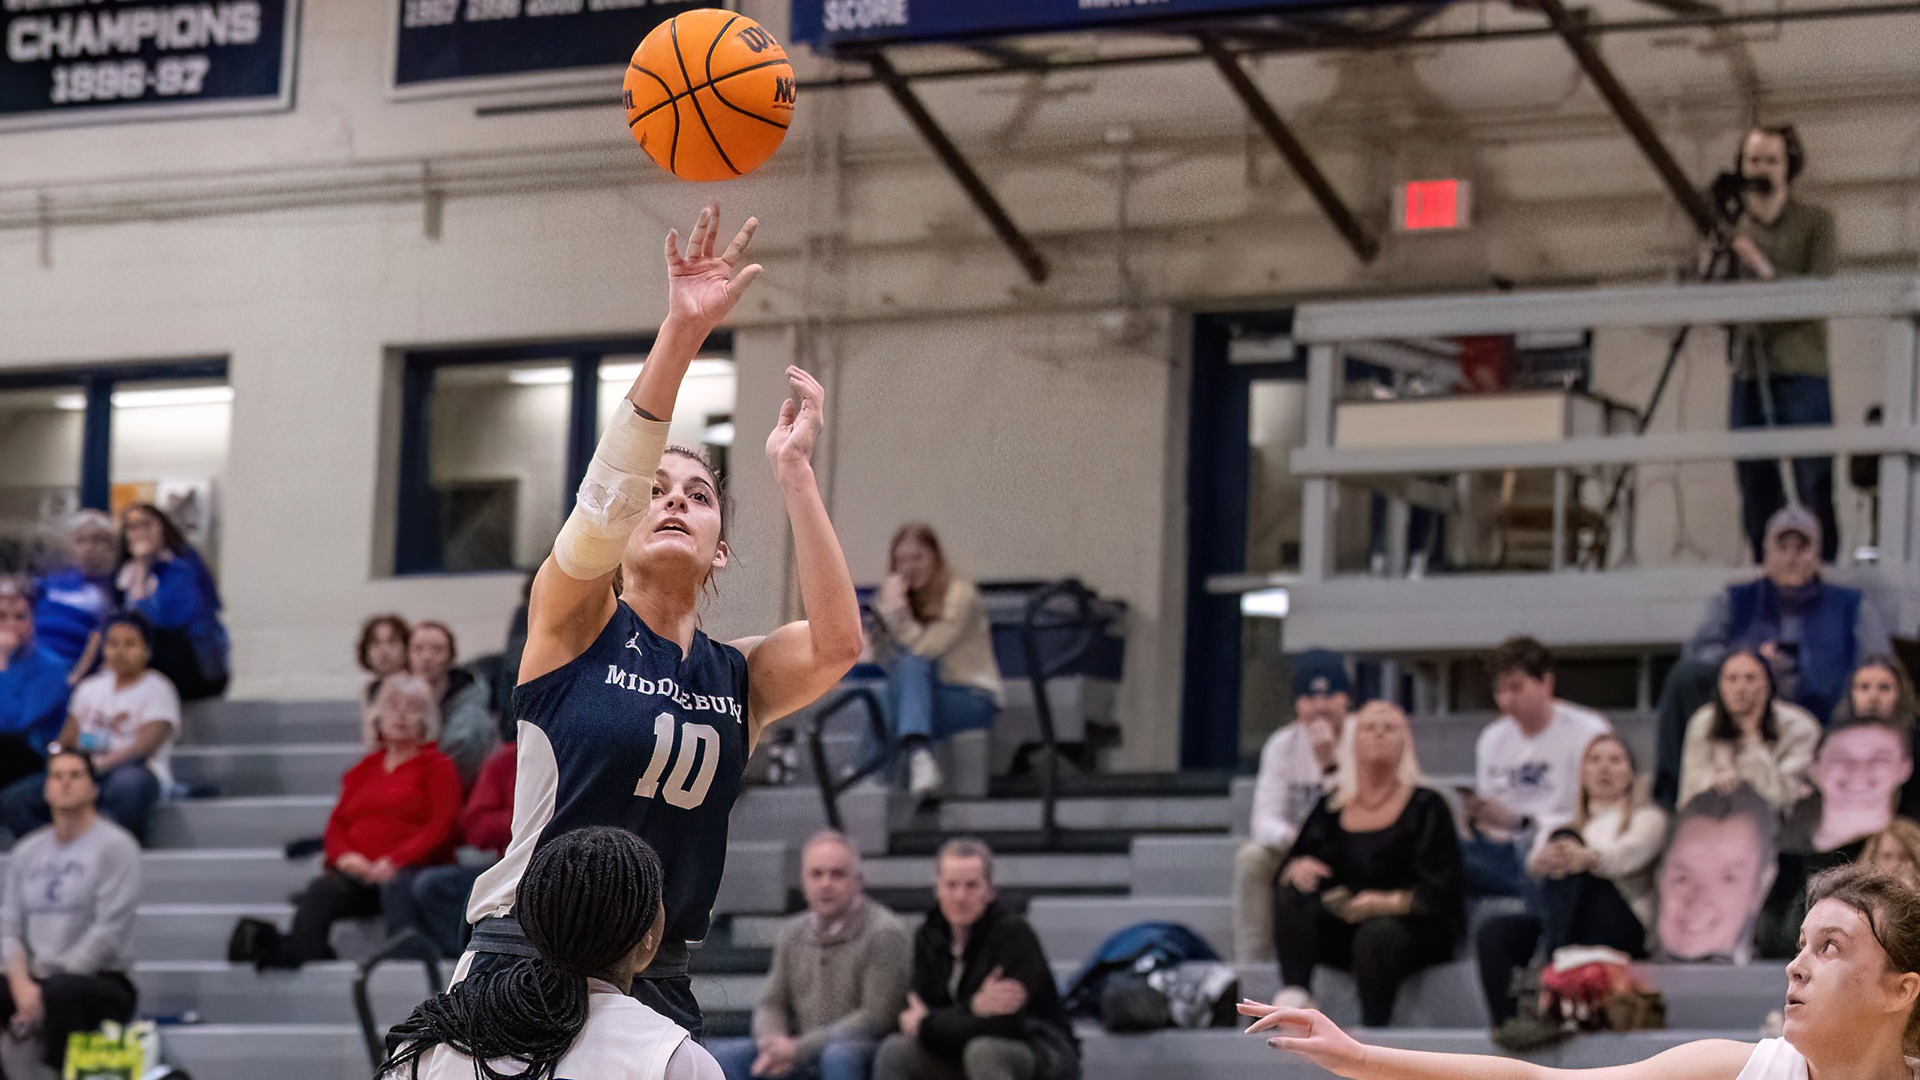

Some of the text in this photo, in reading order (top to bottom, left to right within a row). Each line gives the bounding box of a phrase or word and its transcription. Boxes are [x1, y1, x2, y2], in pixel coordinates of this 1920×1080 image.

[8, 2, 261, 61] CHAMPIONS
[822, 0, 909, 31] SCORE
[633, 711, 720, 810] 10
